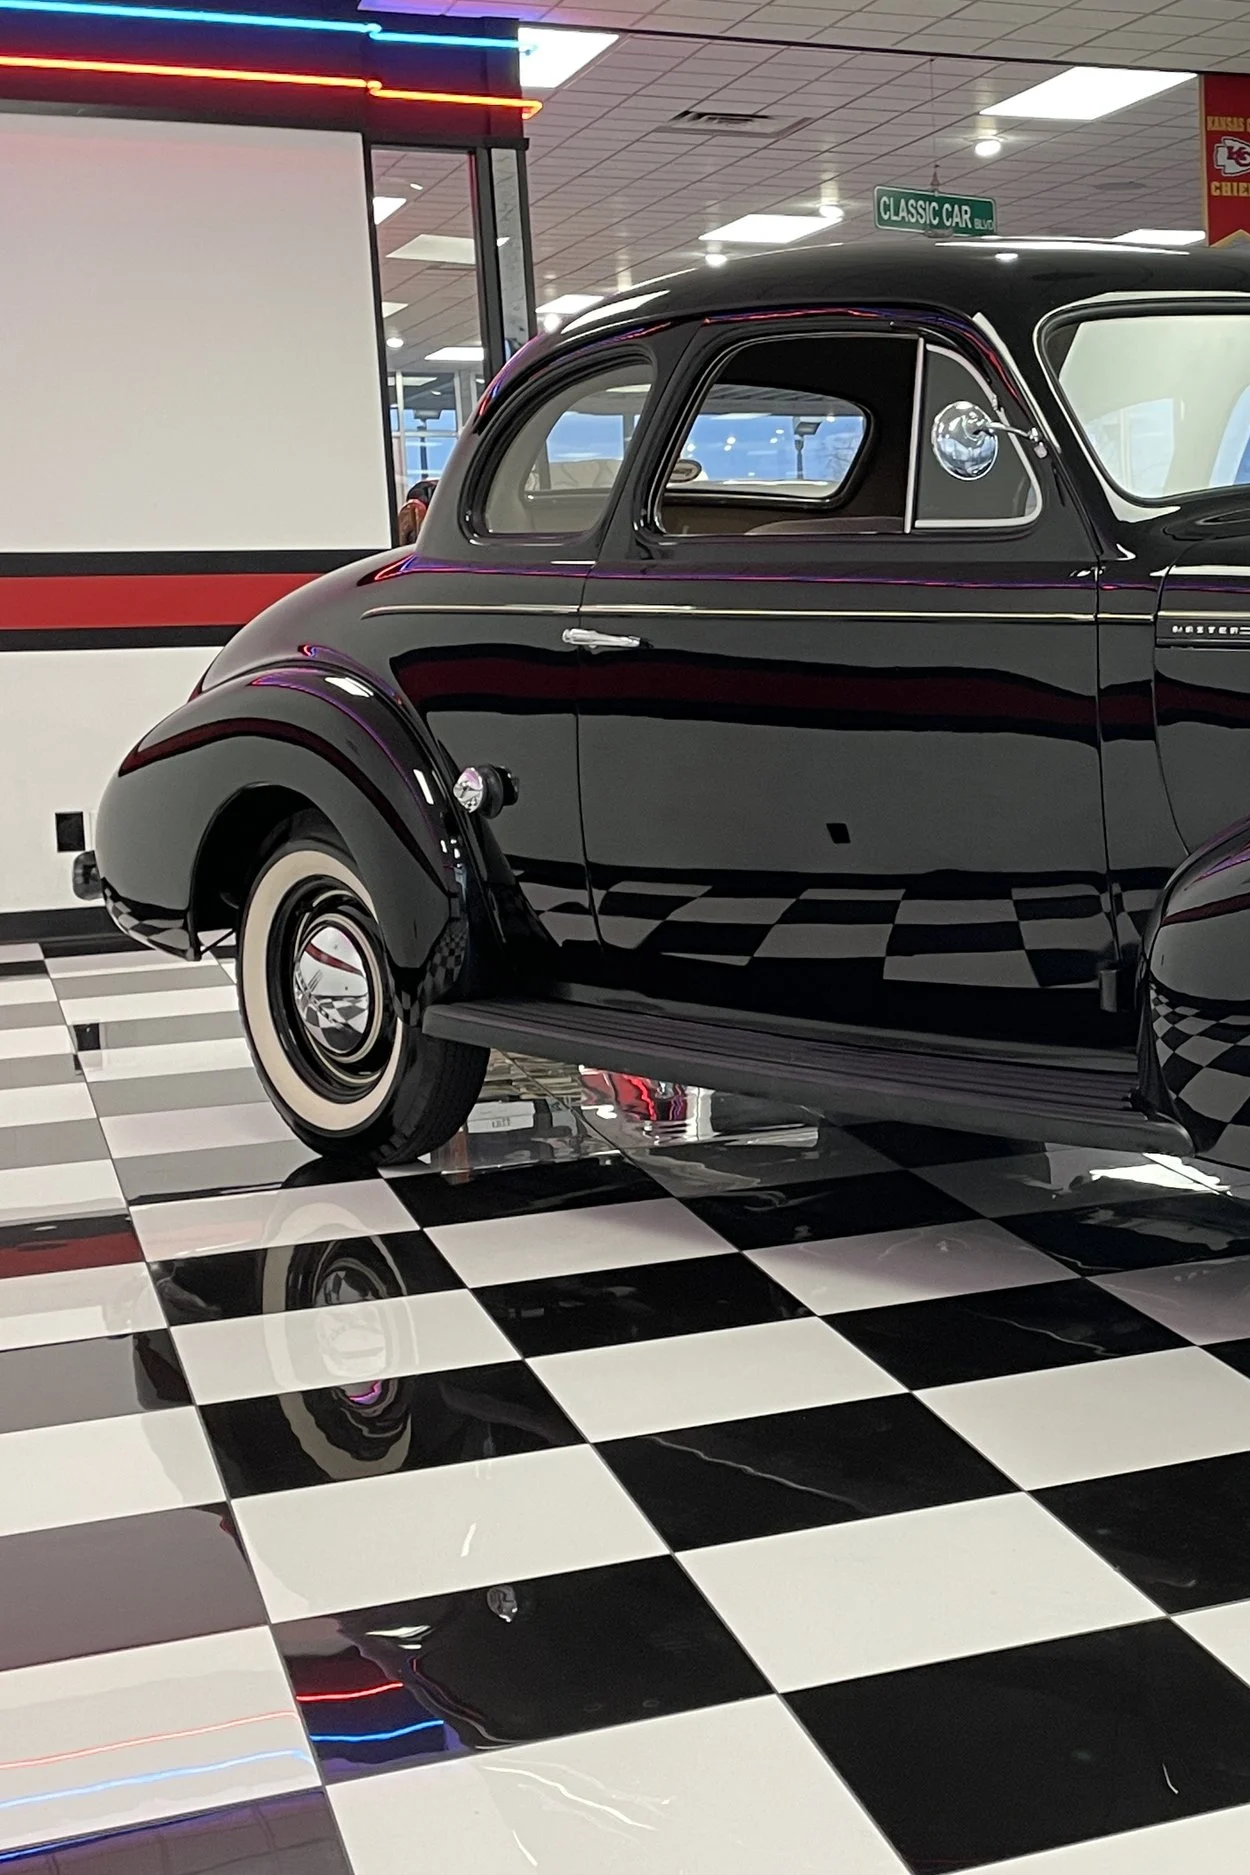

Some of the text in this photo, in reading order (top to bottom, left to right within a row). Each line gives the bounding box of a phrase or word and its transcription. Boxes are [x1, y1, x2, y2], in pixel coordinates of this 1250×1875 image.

[1207, 115, 1244, 133] KANSAS
[879, 196, 995, 231] CLASSIC CAR BLVD
